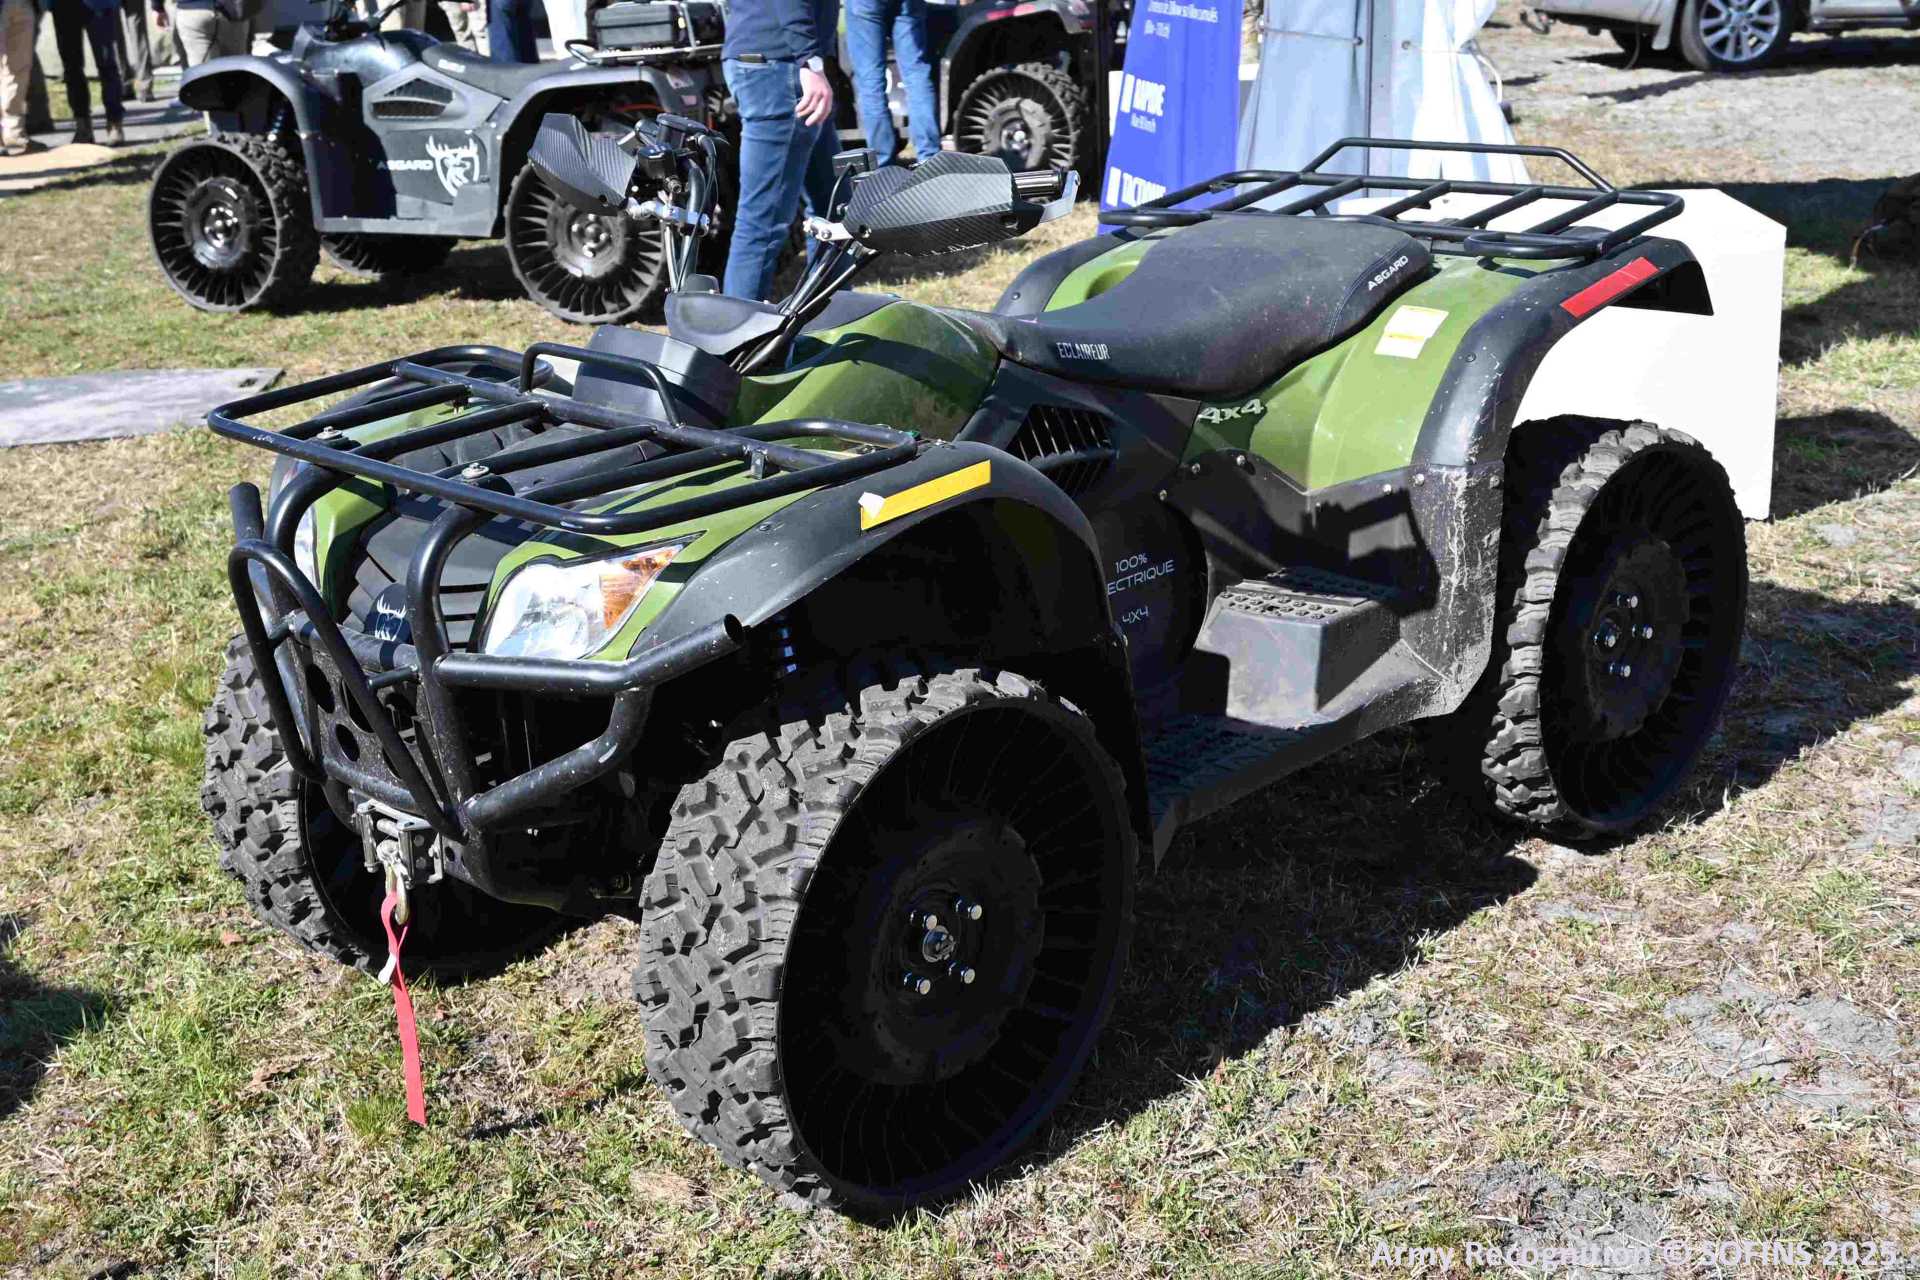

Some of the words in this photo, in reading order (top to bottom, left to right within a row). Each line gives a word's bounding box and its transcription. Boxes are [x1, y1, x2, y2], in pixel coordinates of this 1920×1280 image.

[1367, 255, 1409, 291] ASGARD
[1056, 341, 1111, 361] ECLAIREUR
[1115, 553, 1148, 574] 100%
[1106, 559, 1175, 597] ECTRIQUE
[1122, 605, 1149, 624] 4X4
